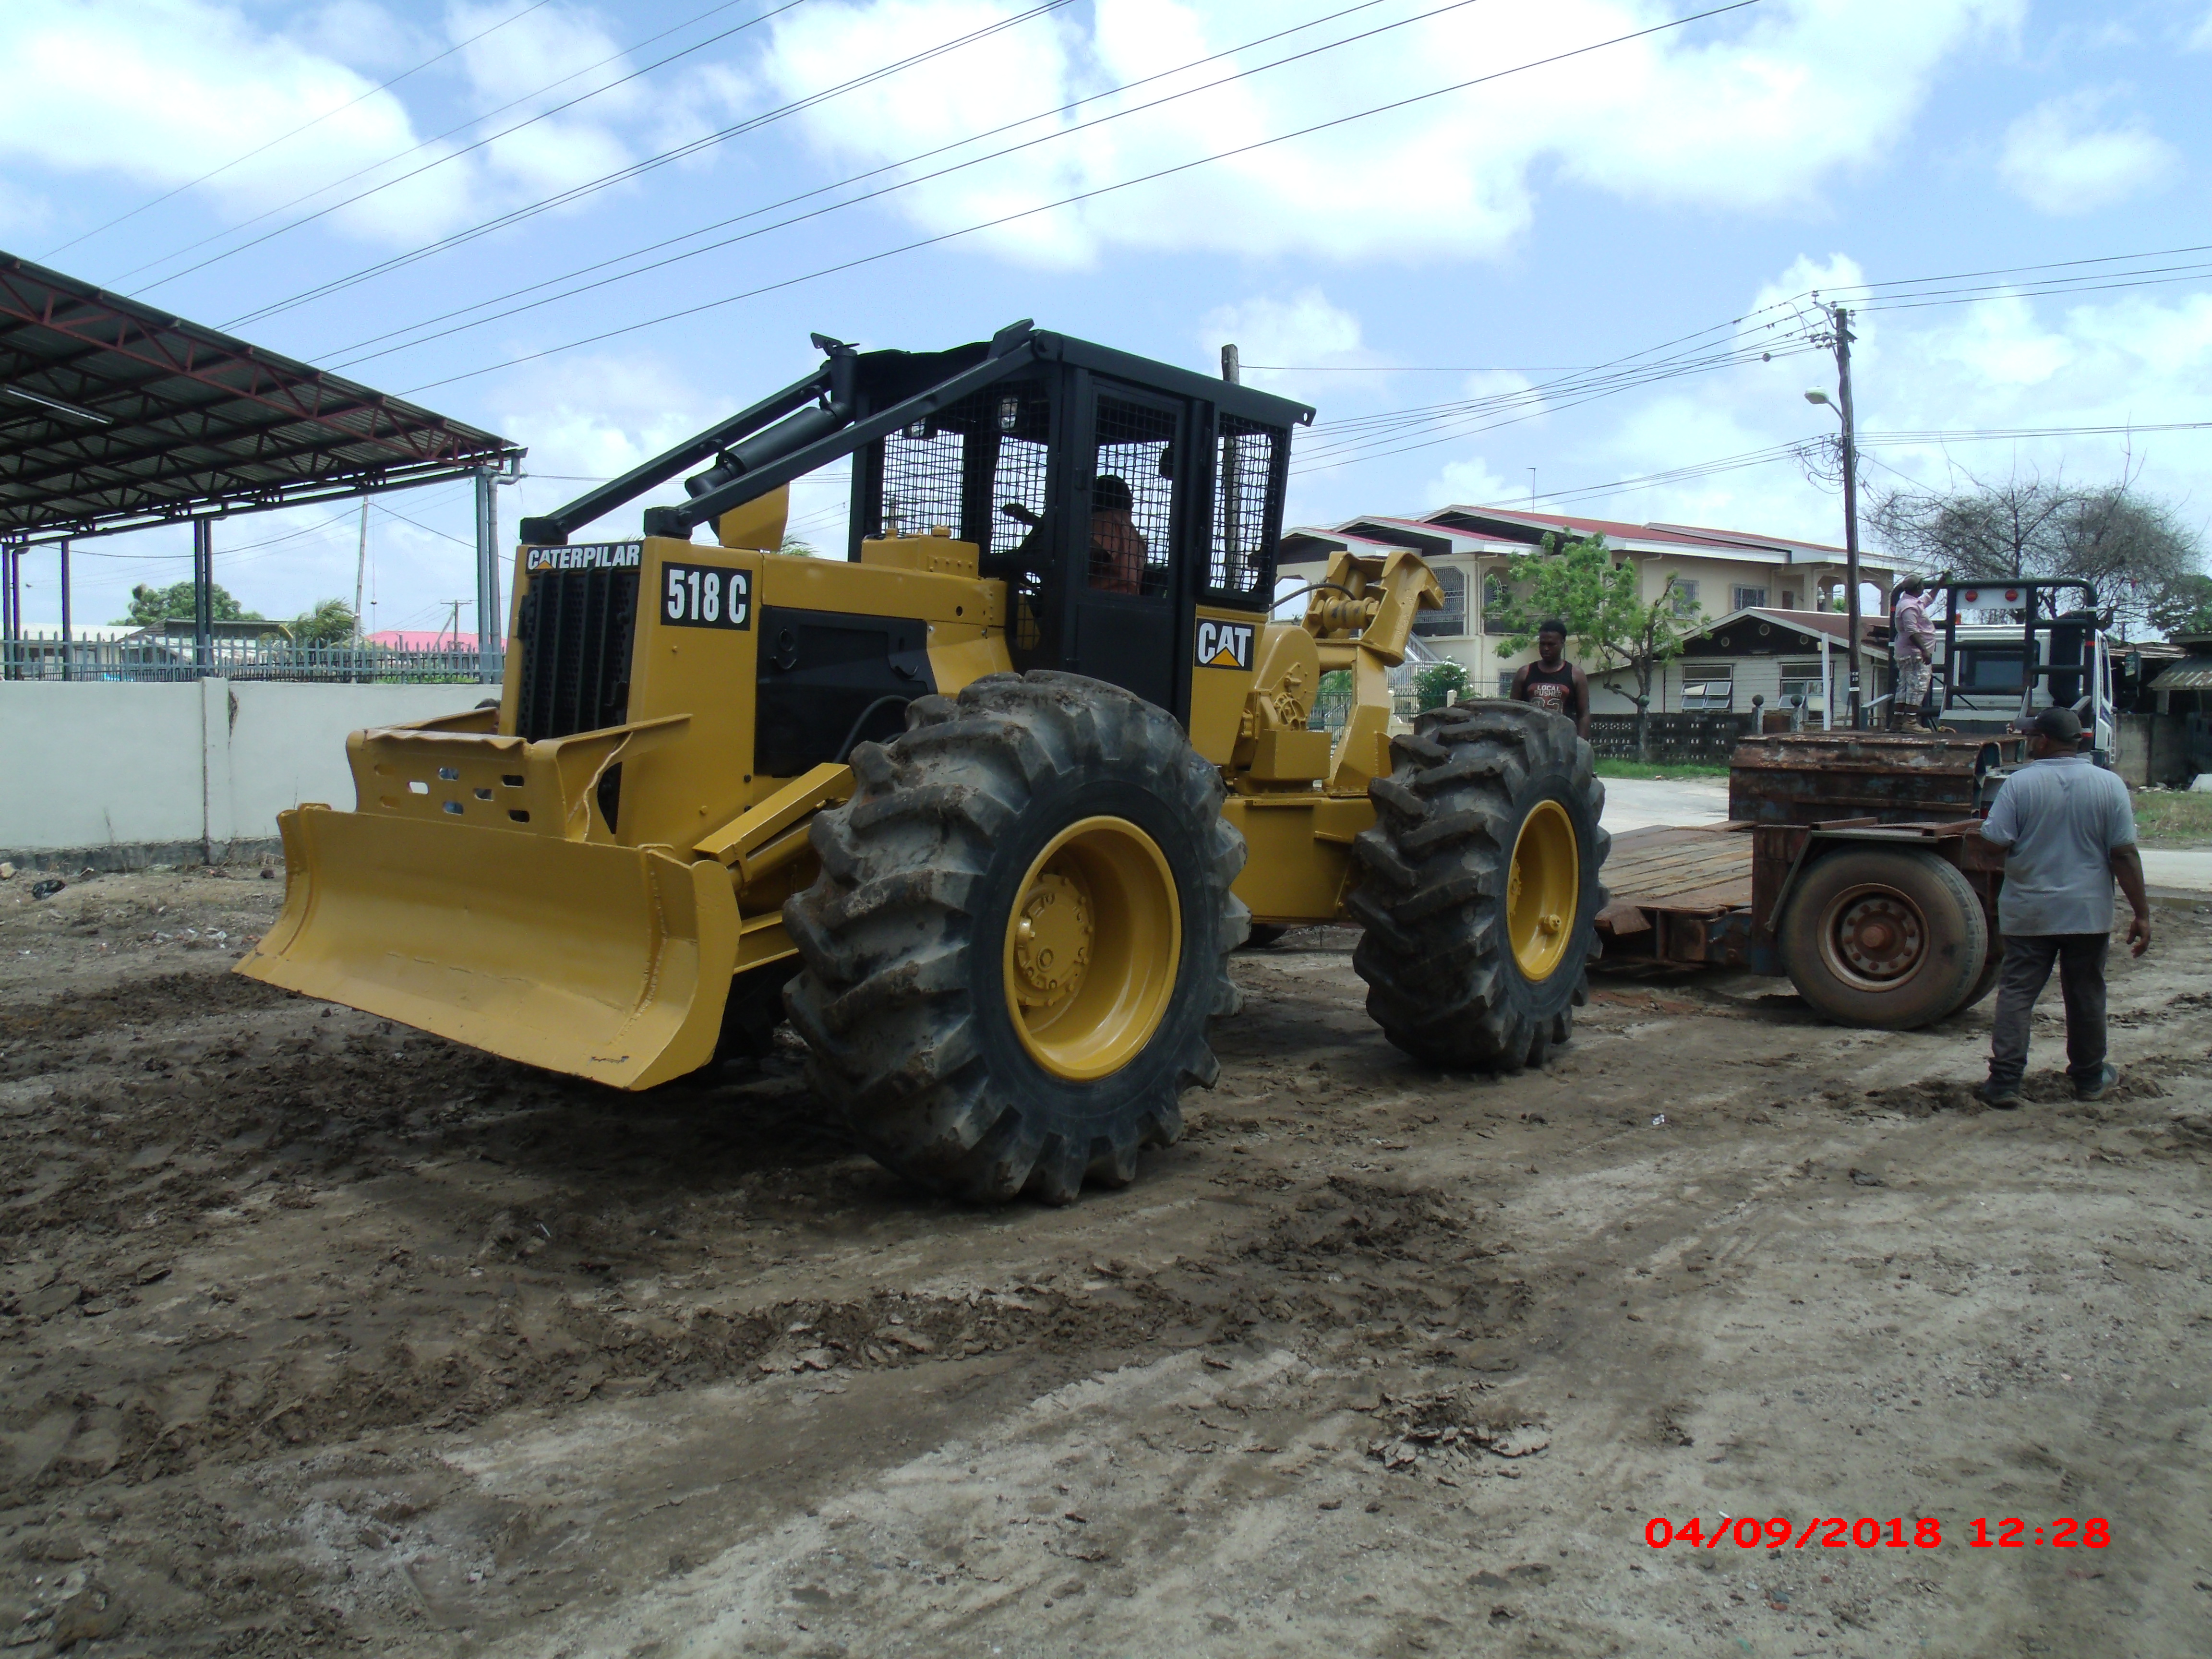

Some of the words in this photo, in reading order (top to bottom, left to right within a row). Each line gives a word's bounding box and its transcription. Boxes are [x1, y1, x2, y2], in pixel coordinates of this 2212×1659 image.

[529, 545, 640, 570] CATERPILAR
[668, 569, 720, 622] 518
[729, 575, 746, 624] C
[1198, 623, 1251, 667] CAT
